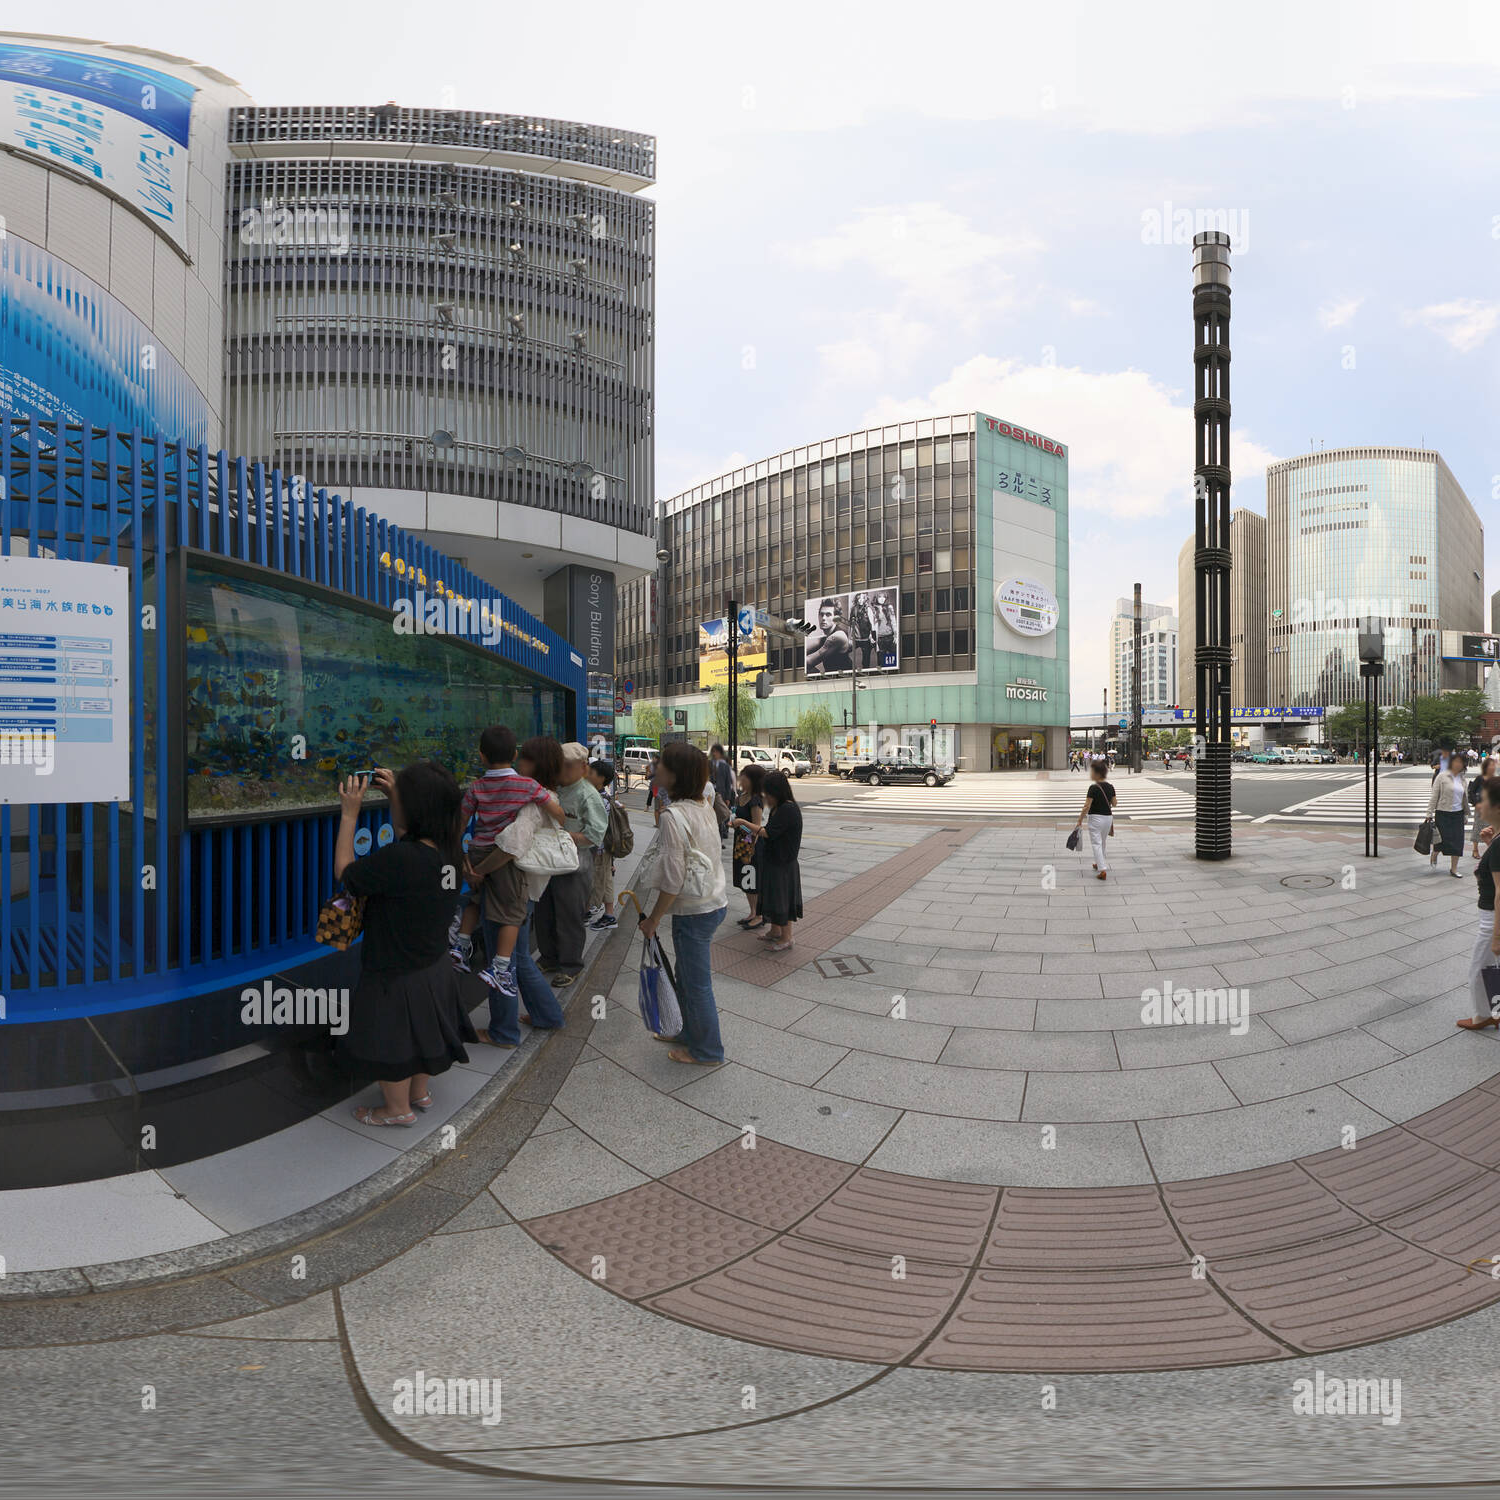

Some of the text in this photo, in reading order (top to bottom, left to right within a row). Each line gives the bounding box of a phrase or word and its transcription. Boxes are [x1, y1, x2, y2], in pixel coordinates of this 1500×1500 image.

[985, 417, 1065, 458] TOSHIBA
[379, 551, 427, 587] 40th
[587, 574, 603, 666] Sony Building
[1006, 687, 1048, 701] MOSAIC
